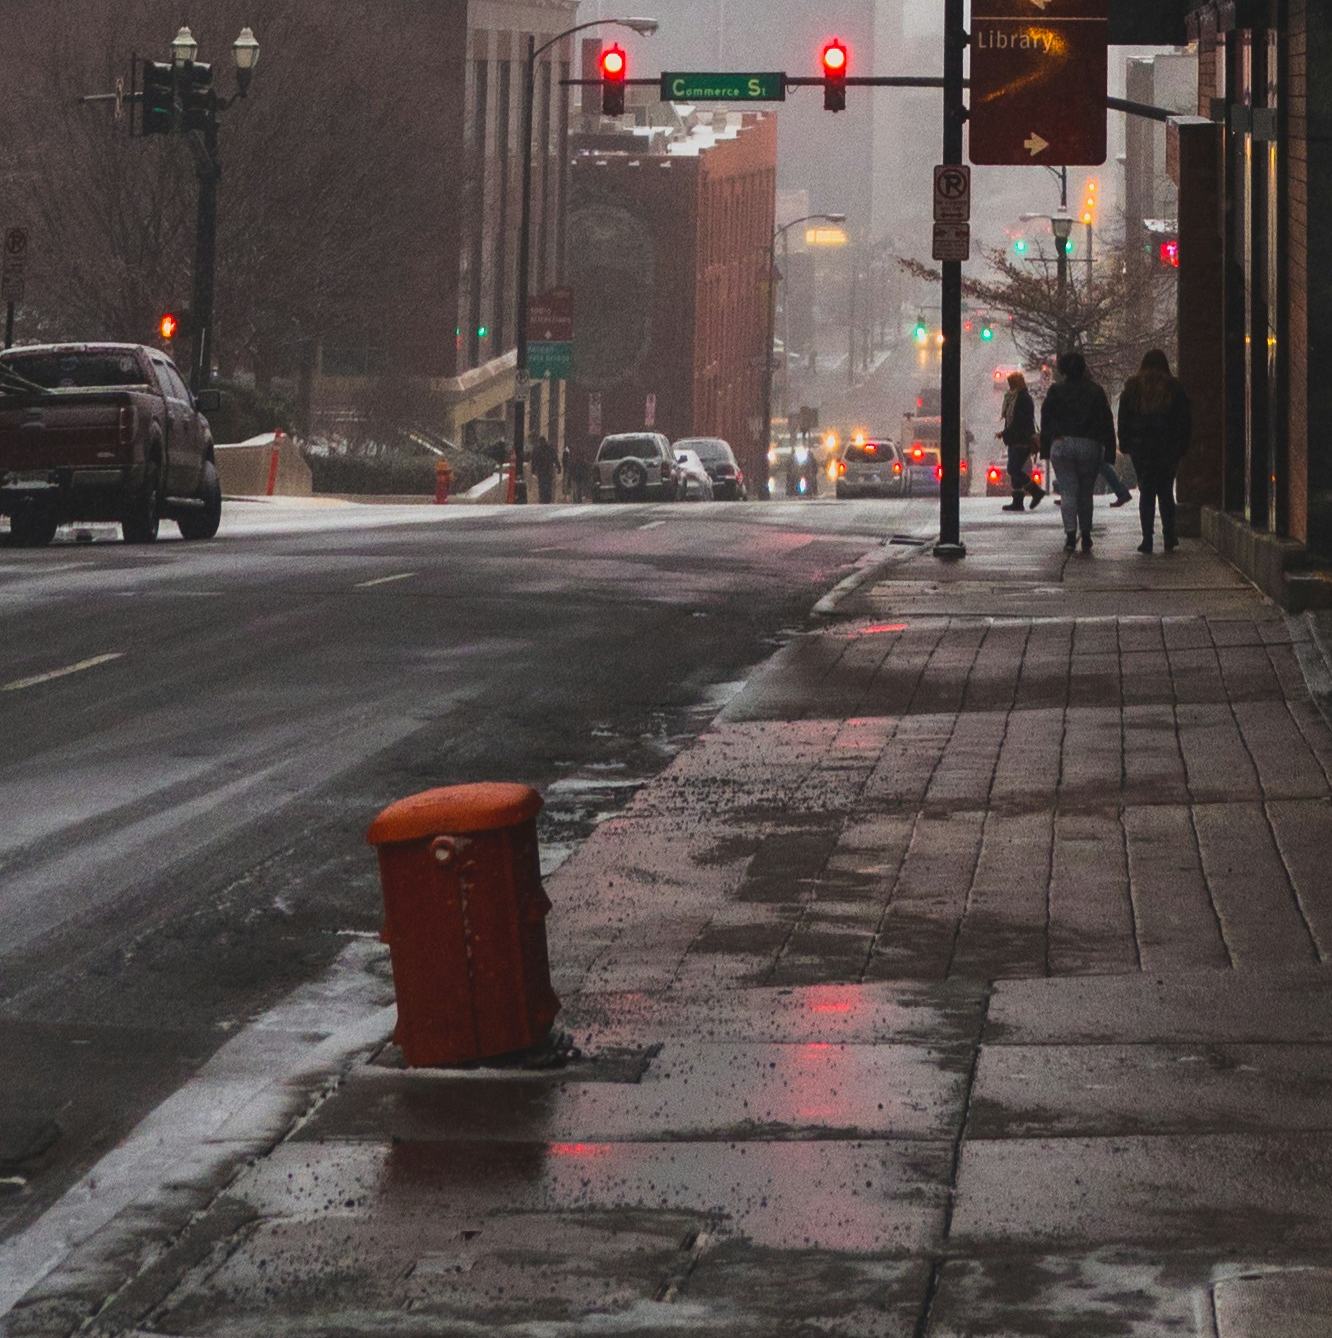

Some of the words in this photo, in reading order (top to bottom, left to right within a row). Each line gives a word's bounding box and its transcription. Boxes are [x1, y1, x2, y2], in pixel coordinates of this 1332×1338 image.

[978, 30, 1054, 54] Library
[672, 78, 740, 97] Commerce
[747, 78, 767, 97] St
